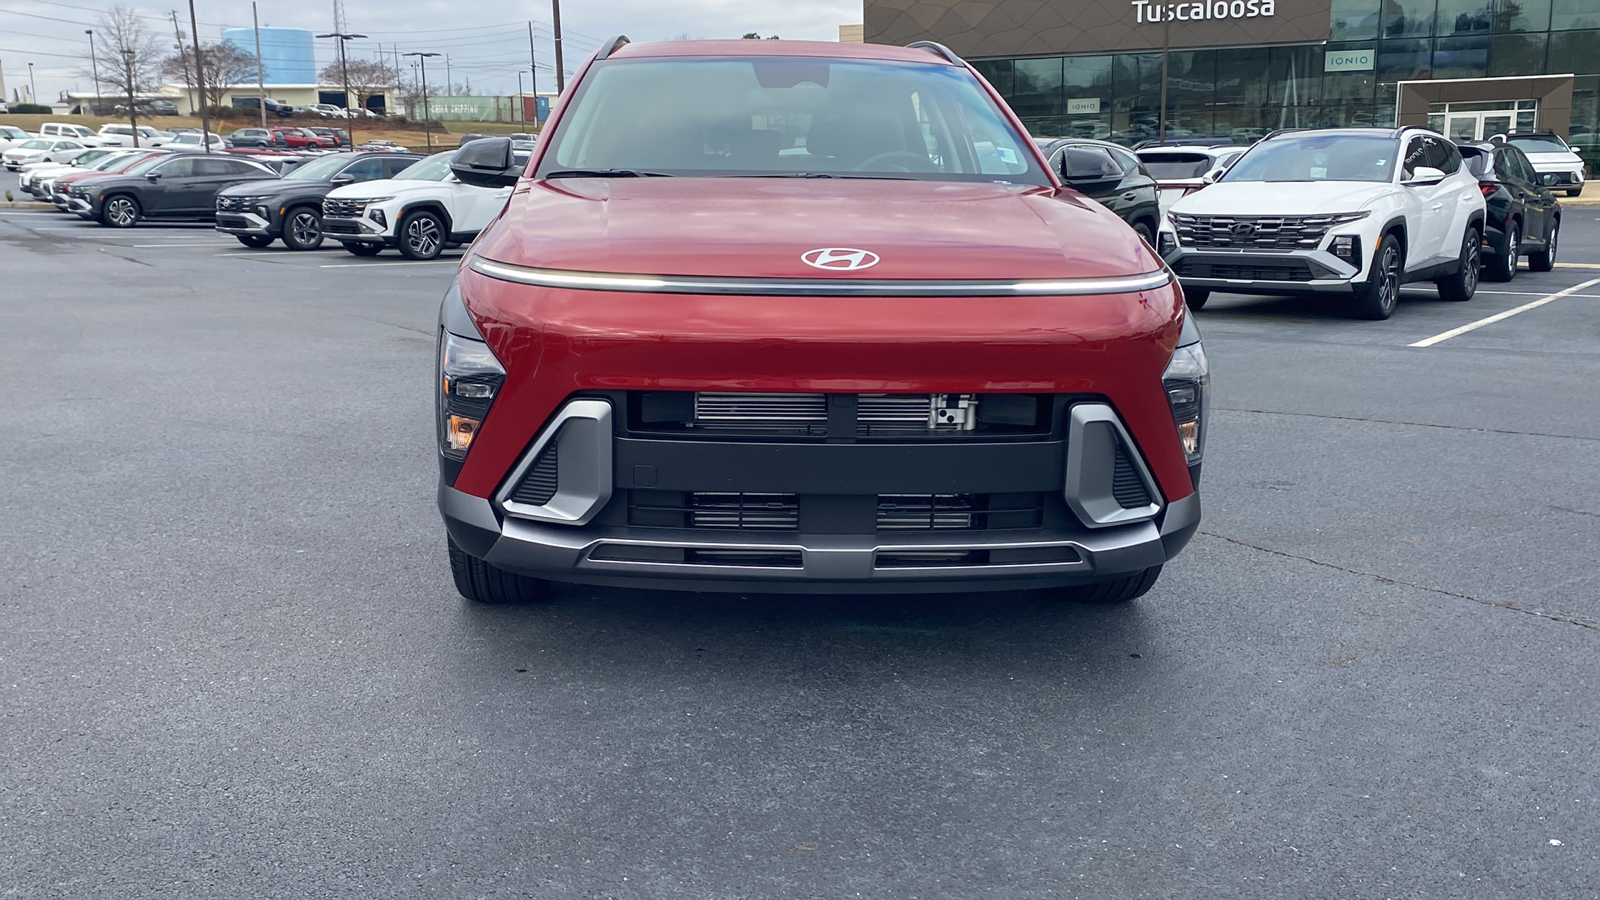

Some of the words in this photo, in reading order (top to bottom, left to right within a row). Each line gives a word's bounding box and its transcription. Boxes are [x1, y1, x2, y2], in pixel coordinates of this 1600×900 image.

[1132, 0, 1275, 23] Tuscaloosa
[1331, 56, 1368, 65] IONIQ
[450, 104, 479, 114] SHIPPING
